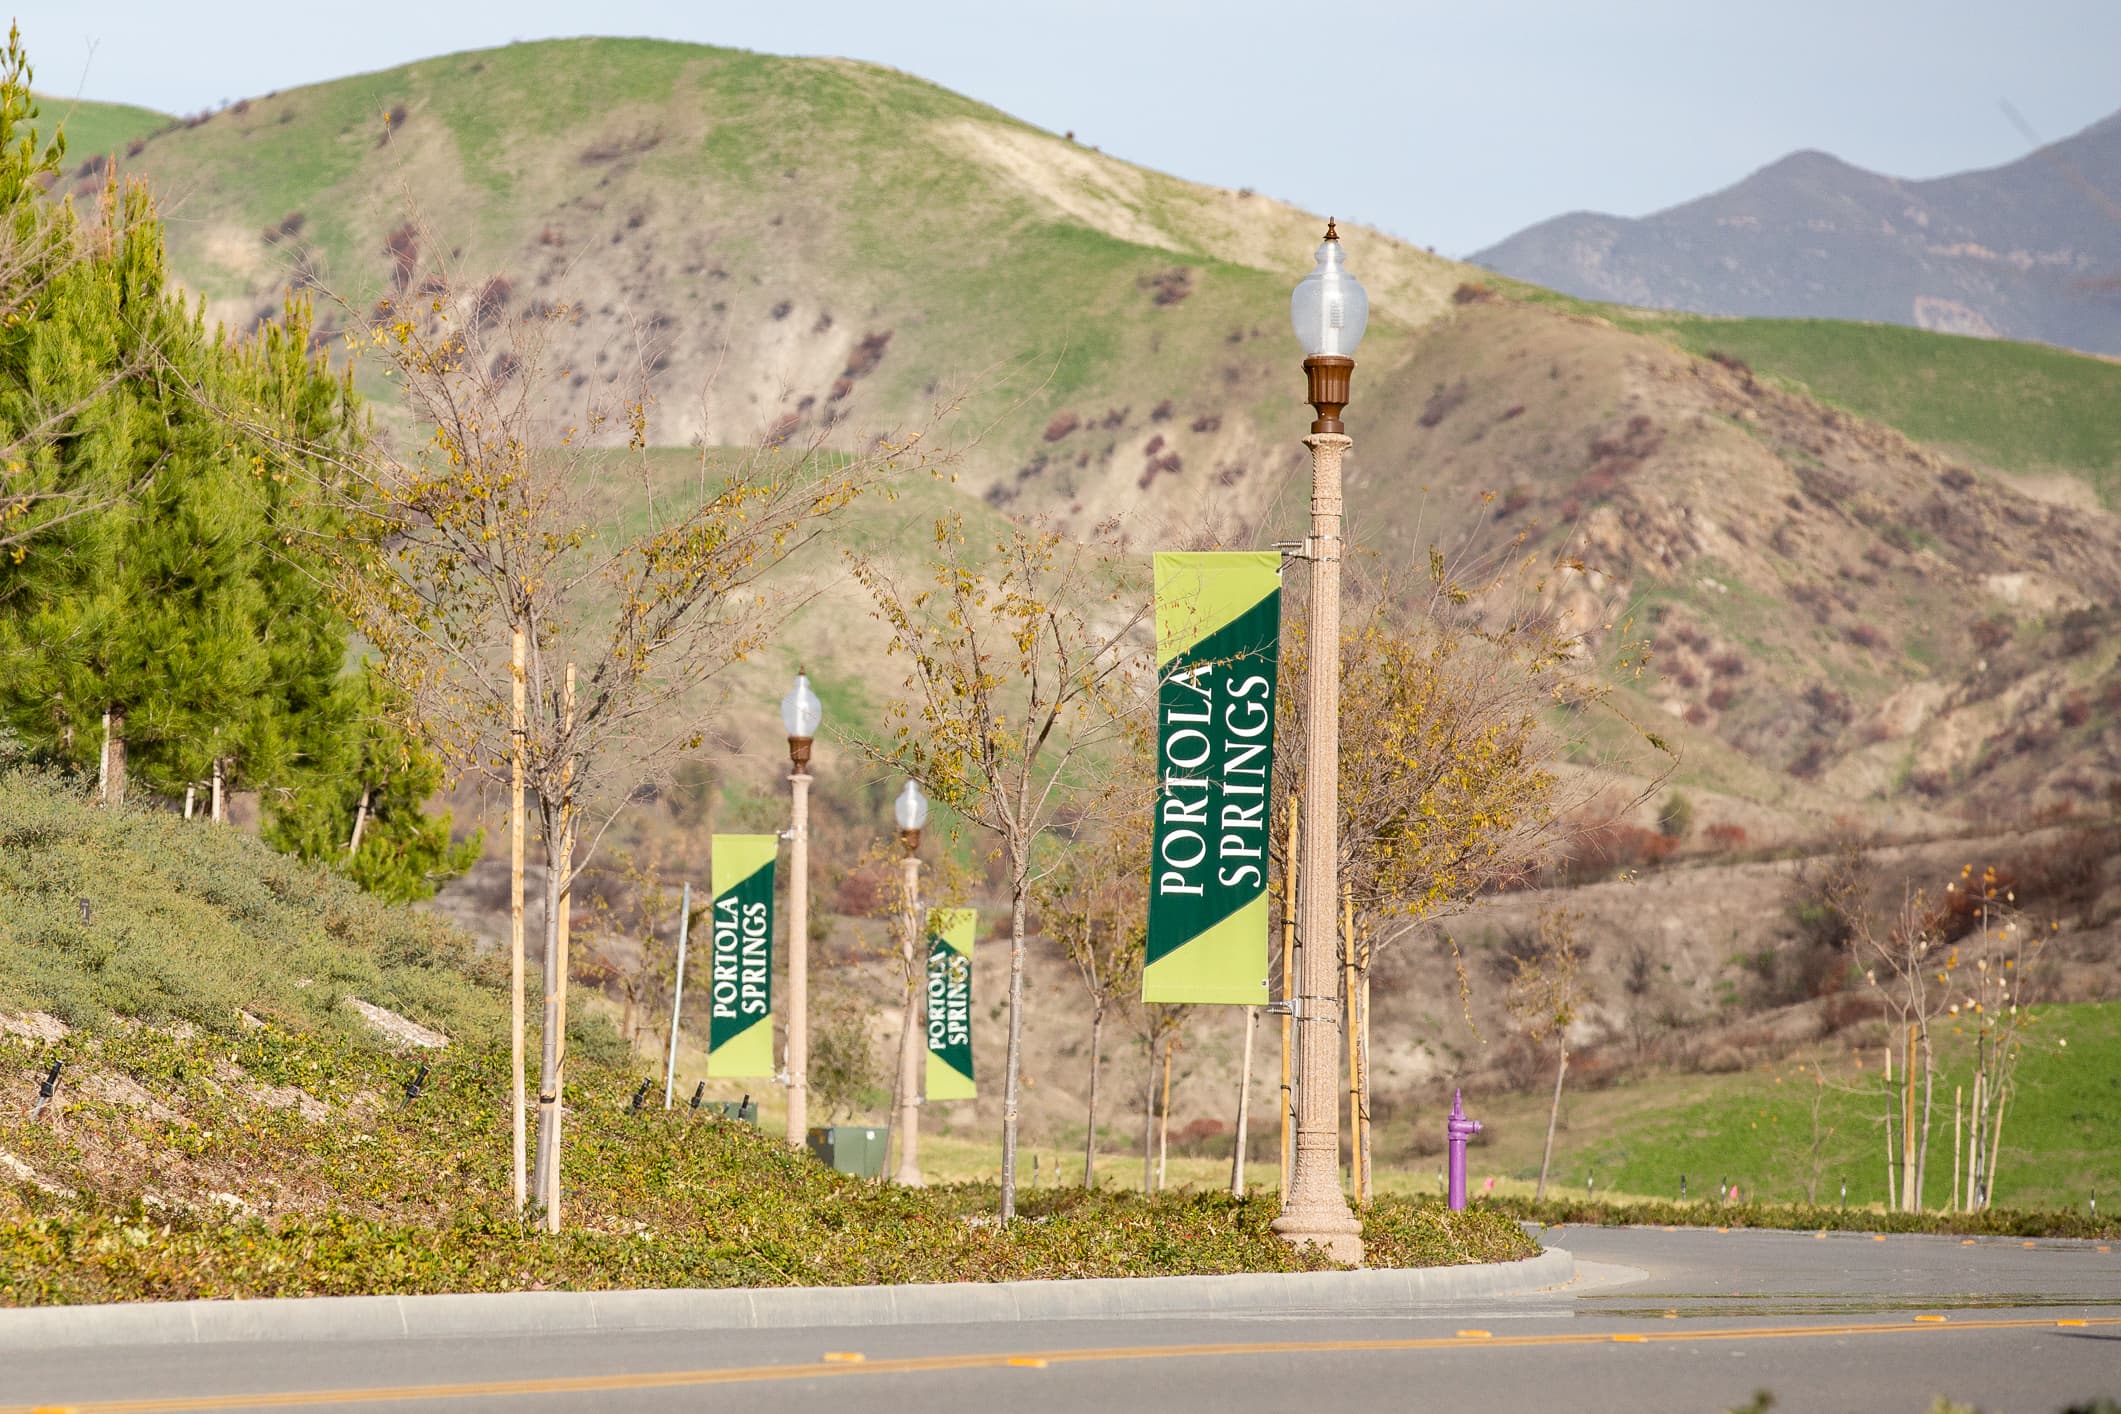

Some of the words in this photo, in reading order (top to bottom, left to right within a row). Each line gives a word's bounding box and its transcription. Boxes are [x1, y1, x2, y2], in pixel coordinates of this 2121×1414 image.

[1160, 663, 1213, 896] PORTOLA
[1219, 675, 1270, 888] SPRINGS
[714, 896, 739, 1018] PORTOLA
[741, 902, 767, 1014] SPRINGS
